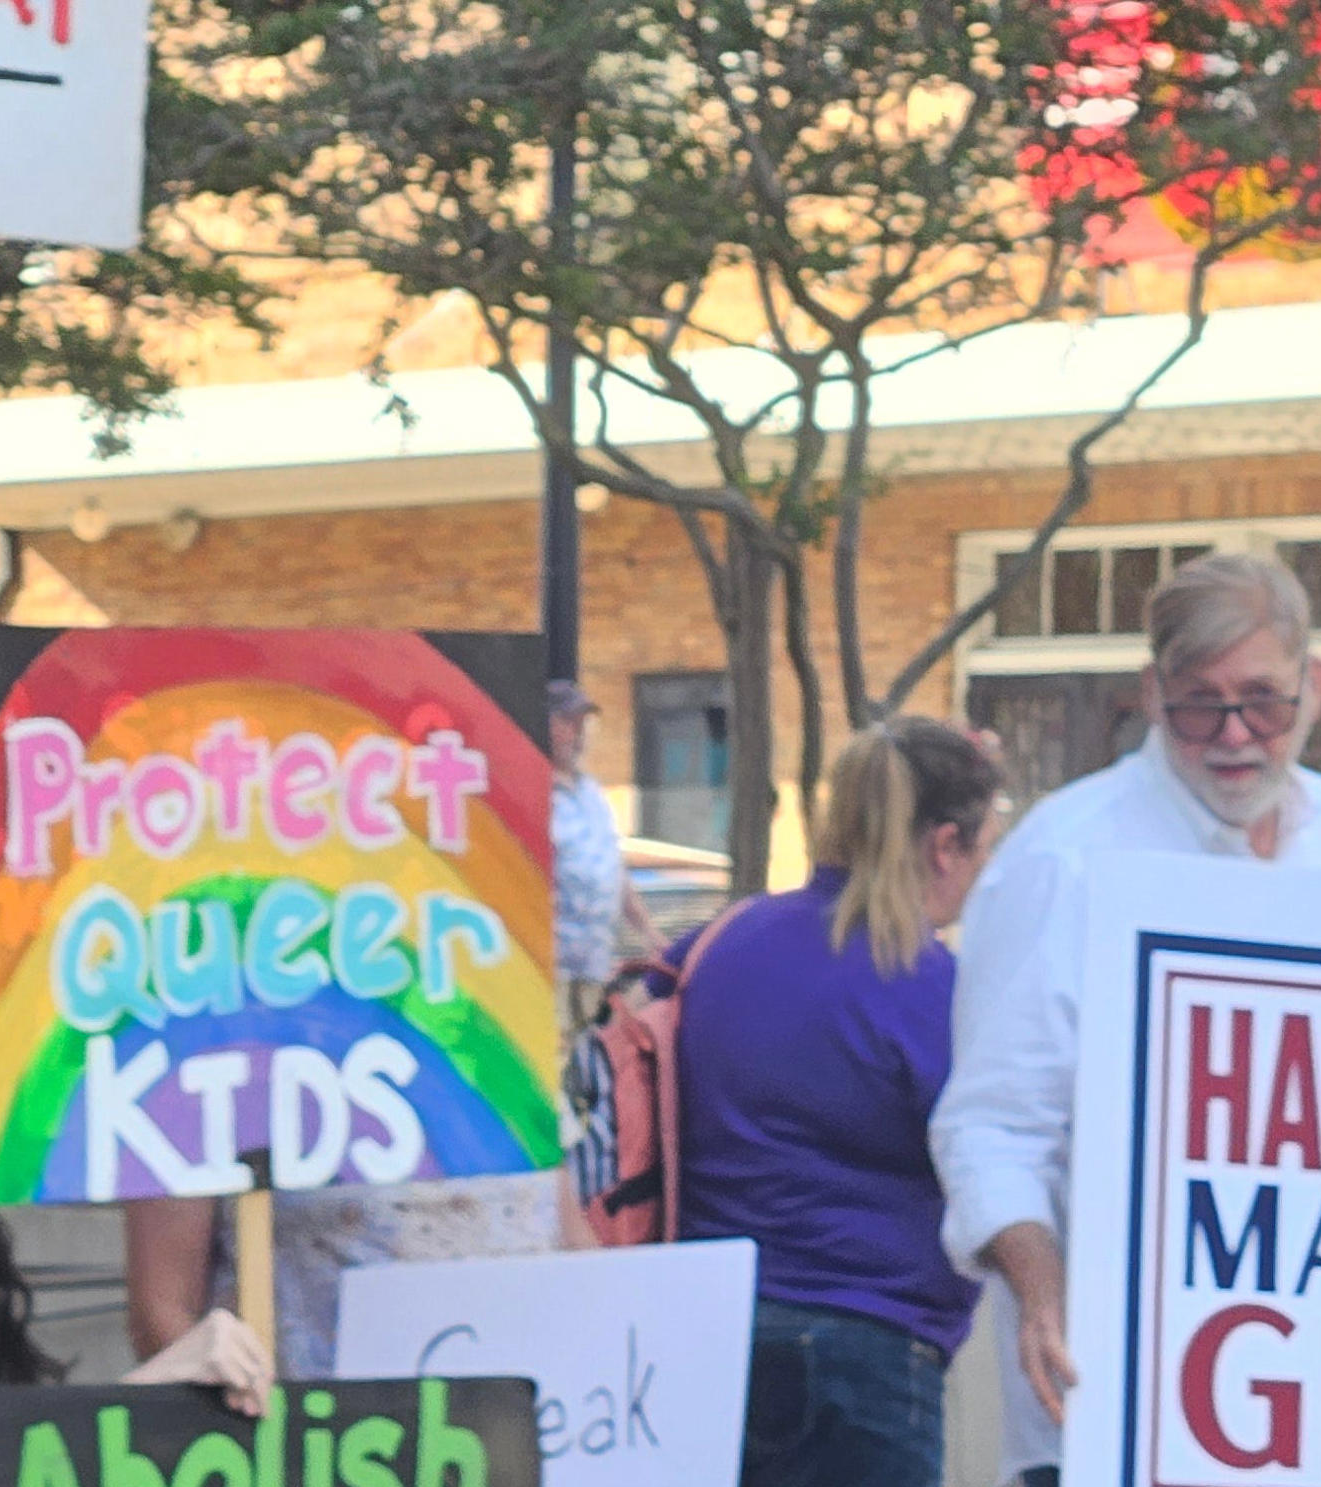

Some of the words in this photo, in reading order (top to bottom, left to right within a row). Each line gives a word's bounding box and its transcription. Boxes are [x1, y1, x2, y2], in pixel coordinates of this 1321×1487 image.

[3, 717, 488, 875] Protect
[51, 884, 508, 1031] Queer
[85, 1034, 425, 1201] KIDS
